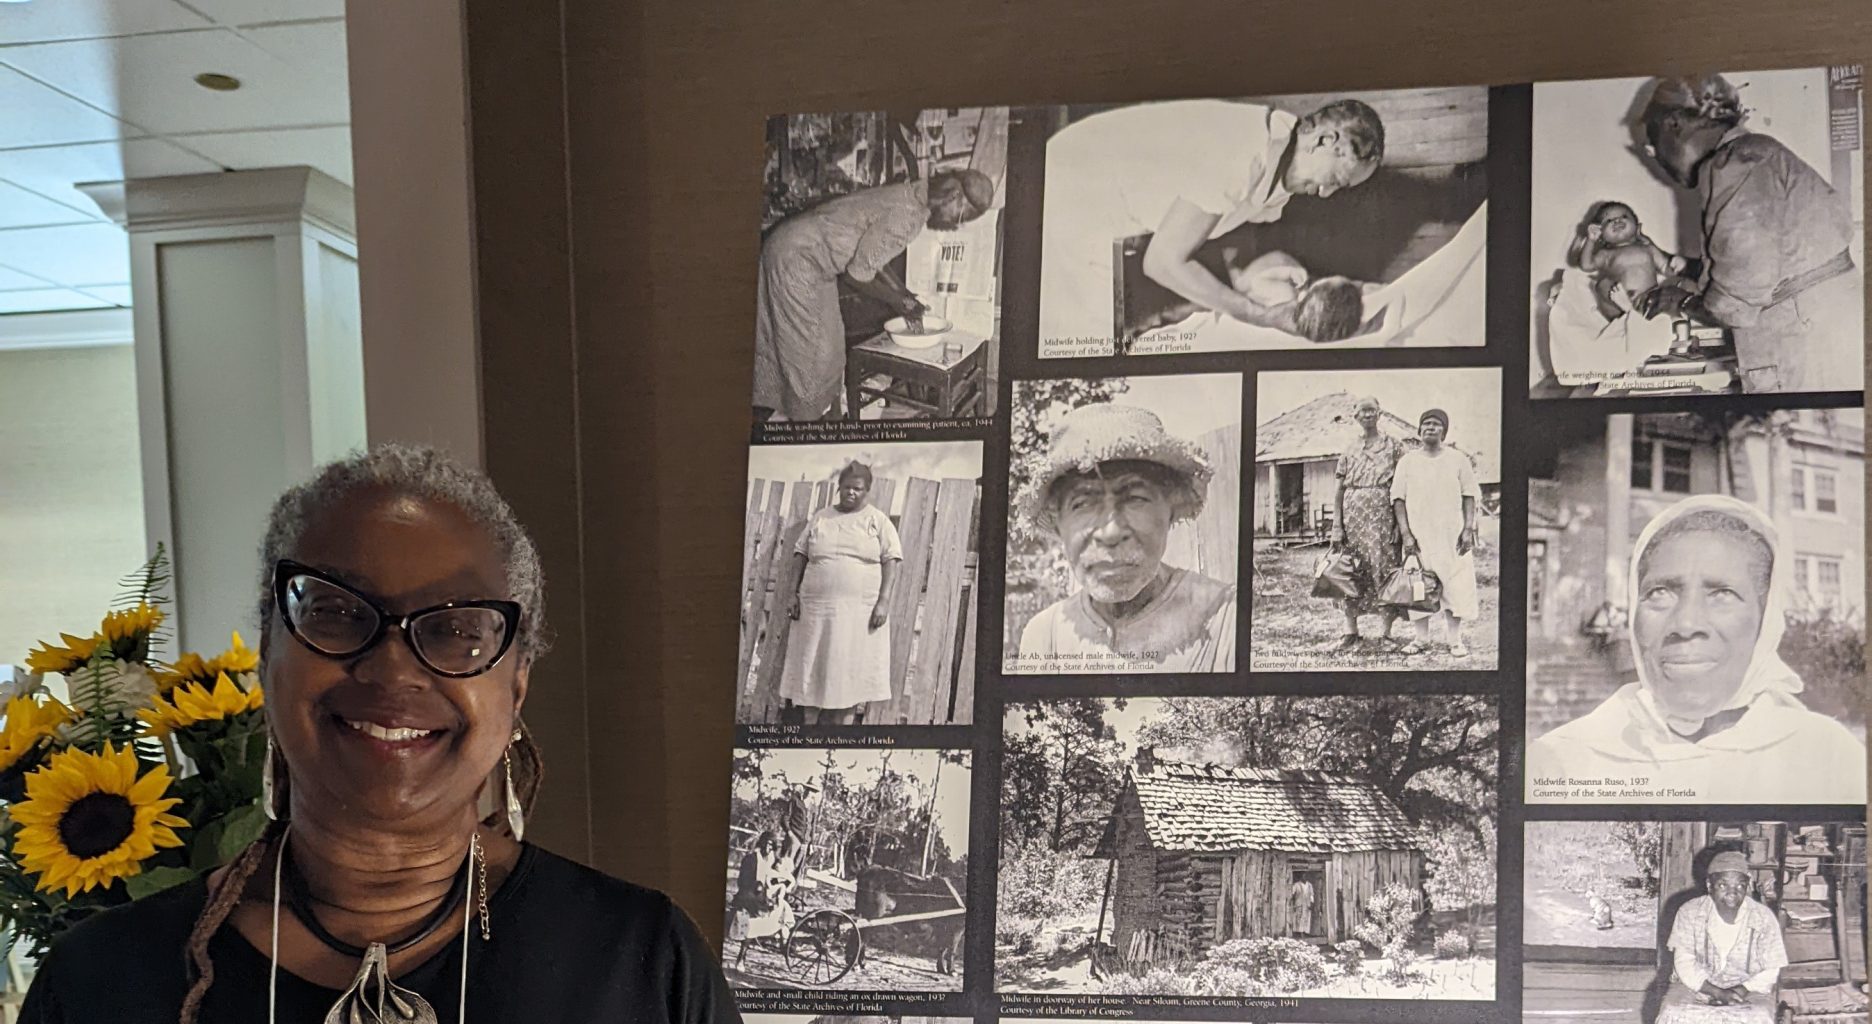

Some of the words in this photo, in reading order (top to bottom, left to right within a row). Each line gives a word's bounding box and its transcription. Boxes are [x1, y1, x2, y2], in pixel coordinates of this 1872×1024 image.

[941, 246, 964, 261] VOTE!
[1044, 336, 1074, 345] Midwife
[1076, 335, 1104, 346] holding
[1157, 333, 1176, 344] baby,
[1044, 347, 1075, 358] Courtesy
[1078, 347, 1087, 355] of
[1088, 346, 1100, 354] the
[1154, 344, 1164, 352] of
[1164, 343, 1192, 352] Florida
[1572, 370, 1607, 380] weighing
[1621, 379, 1655, 388] Archives
[1657, 379, 1667, 387] of
[1668, 378, 1696, 387] Florida
[1028, 652, 1042, 661] Ab,
[1086, 651, 1104, 660] male
[1106, 651, 1139, 660] midwife,
[1142, 651, 1159, 659] 192?
[1004, 663, 1038, 672] Courtesy
[1063, 662, 1082, 670] State
[1083, 662, 1116, 670] Archives
[1127, 662, 1154, 670] Florida
[1254, 660, 1286, 671] Courtesy
[1300, 660, 1313, 668] the
[1604, 778, 1627, 787] Ruso,
[1630, 778, 1649, 786] 193?
[1533, 789, 1568, 799] Courtesy
[1571, 789, 1580, 797] of
[1582, 789, 1594, 797] the
[1597, 789, 1617, 797] State
[1619, 789, 1654, 797] Archives
[1656, 789, 1666, 797] of
[1667, 789, 1696, 797] Florida
[735, 990, 766, 998] Midwife
[766, 990, 781, 998] and
[804, 991, 824, 999] child
[826, 992, 848, 1002] riding
[872, 992, 896, 1000] drawn
[1001, 994, 1032, 1002] Midwife
[1043, 995, 1075, 1006] doorway
[1088, 996, 1102, 1004] her
[1132, 996, 1150, 1004] Near
[1152, 996, 1180, 1006] Siloam,
[1183, 997, 1211, 1005] Greene
[1213, 998, 1242, 1008] County,
[1280, 998, 1298, 1007] 1941
[769, 1001, 778, 1009] of
[779, 1002, 790, 1010] the
[793, 1002, 811, 1010] State
[813, 1002, 844, 1010] Archives
[856, 1003, 882, 1011] Florida
[1000, 1006, 1034, 1016] Courtesy
[1048, 1006, 1060, 1014] the
[1060, 1006, 1086, 1017] Library
[1099, 1007, 1134, 1017] Congress
